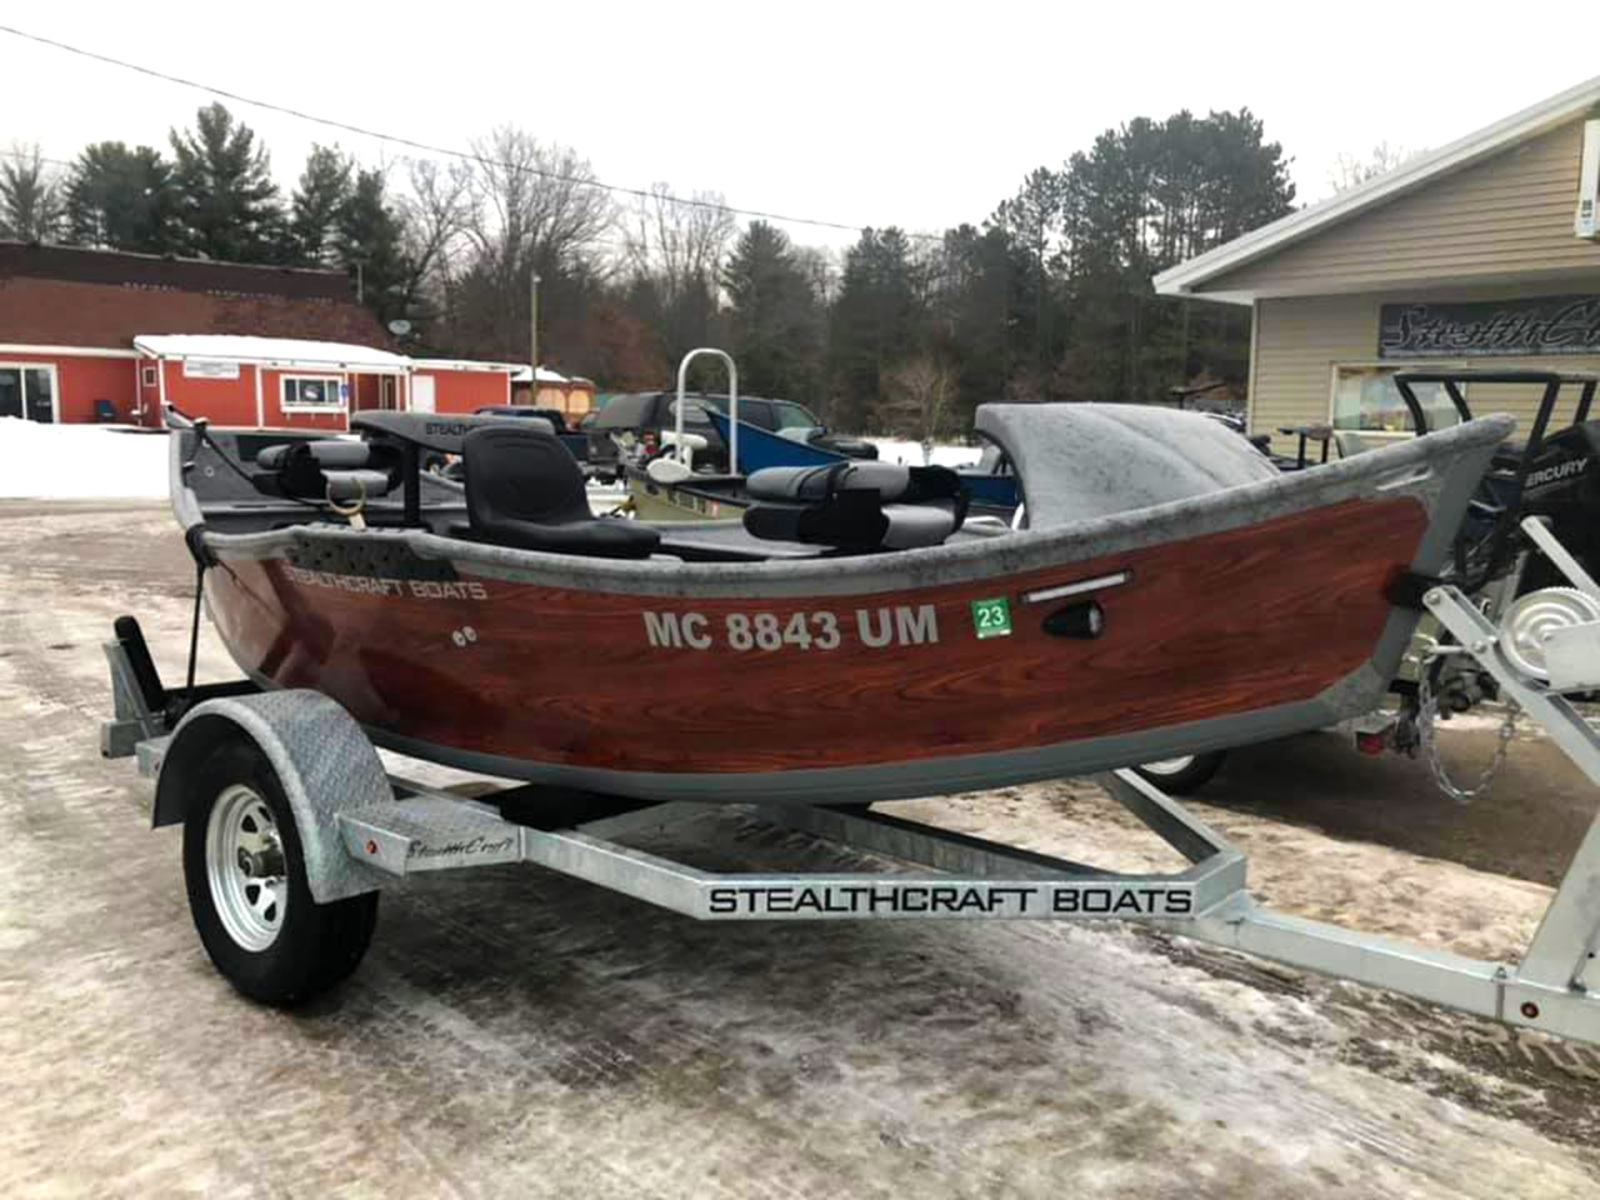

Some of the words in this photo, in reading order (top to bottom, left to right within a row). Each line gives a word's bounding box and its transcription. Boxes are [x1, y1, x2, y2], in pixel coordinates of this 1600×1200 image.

[1525, 457, 1588, 488] ERCURY
[409, 580, 488, 600] BOATS
[643, 610, 713, 650] MC
[725, 611, 841, 651] 8843
[855, 604, 939, 647] UM
[978, 606, 1005, 627] 23
[708, 887, 1038, 914] STEALTHCRAFT
[1052, 887, 1192, 914] BOATS
